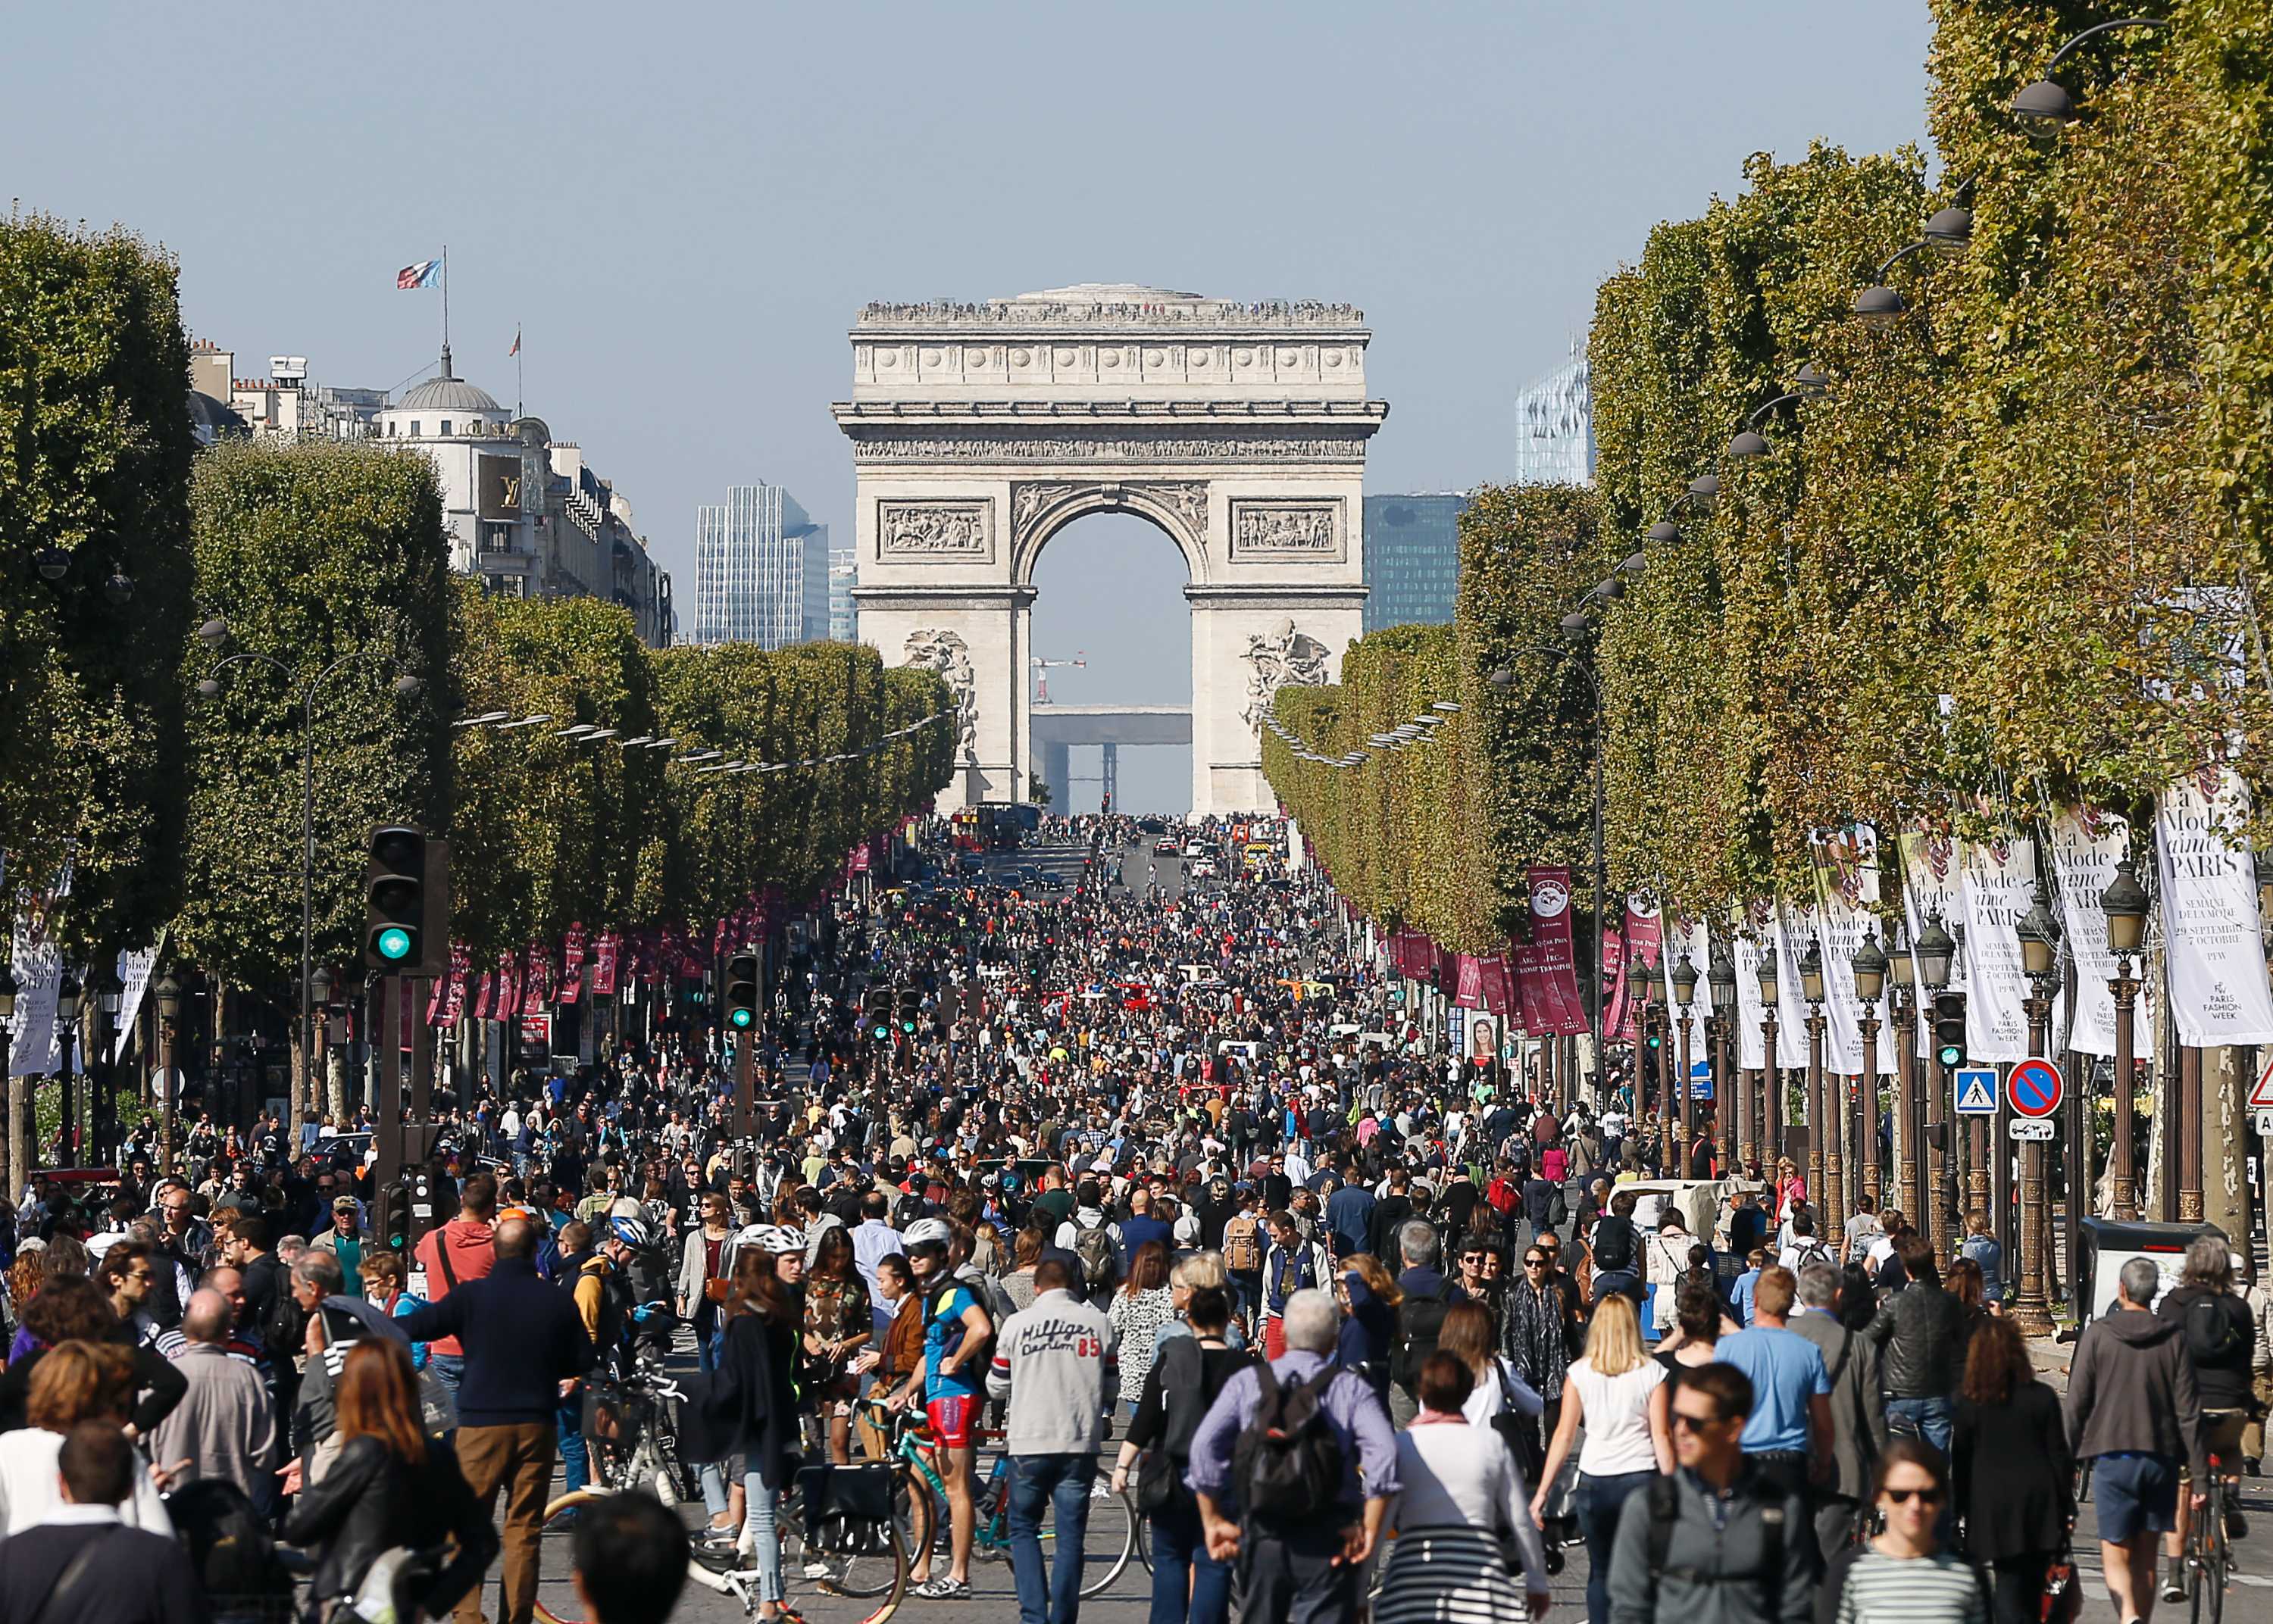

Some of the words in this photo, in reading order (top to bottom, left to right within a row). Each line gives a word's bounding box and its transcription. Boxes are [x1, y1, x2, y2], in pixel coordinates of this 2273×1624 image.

[2165, 807, 2217, 832] Mod
[2170, 853, 2238, 879] PARIS
[2186, 898, 2226, 910] SEMAINE
[2175, 928, 2187, 936] 29
[2189, 936, 2194, 945] 7
[2197, 934, 2243, 945] OCTOBRE
[2203, 1003, 2242, 1011] FASHION
[1021, 1319, 1095, 1344] Hilfiger
[1023, 1341, 1074, 1356] Denim
[1079, 1338, 1101, 1357] 85
